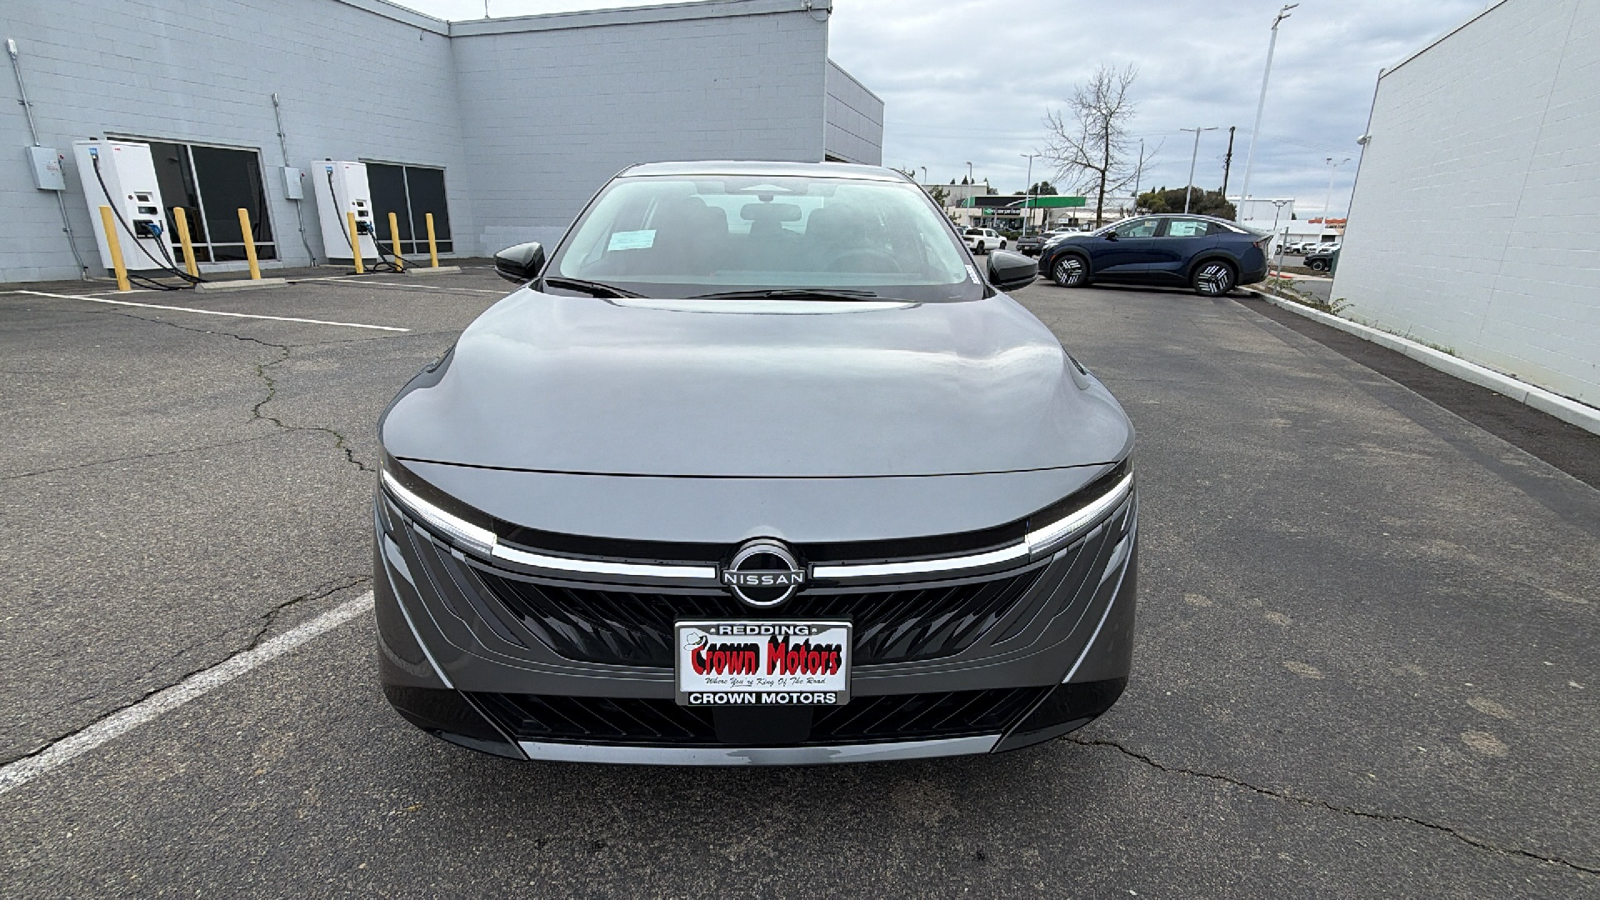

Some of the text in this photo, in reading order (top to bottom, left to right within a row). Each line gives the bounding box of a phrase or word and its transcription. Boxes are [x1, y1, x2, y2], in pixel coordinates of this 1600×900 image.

[724, 573, 803, 585] NISSAN
[719, 625, 809, 635] REDDING
[691, 637, 842, 675] Crown Motors
[705, 677, 728, 685] Where
[756, 677, 775, 687] King
[777, 677, 788, 687] Of
[790, 677, 803, 685] The
[806, 677, 826, 685] Road
[689, 692, 837, 704] CROWN MOTORS
